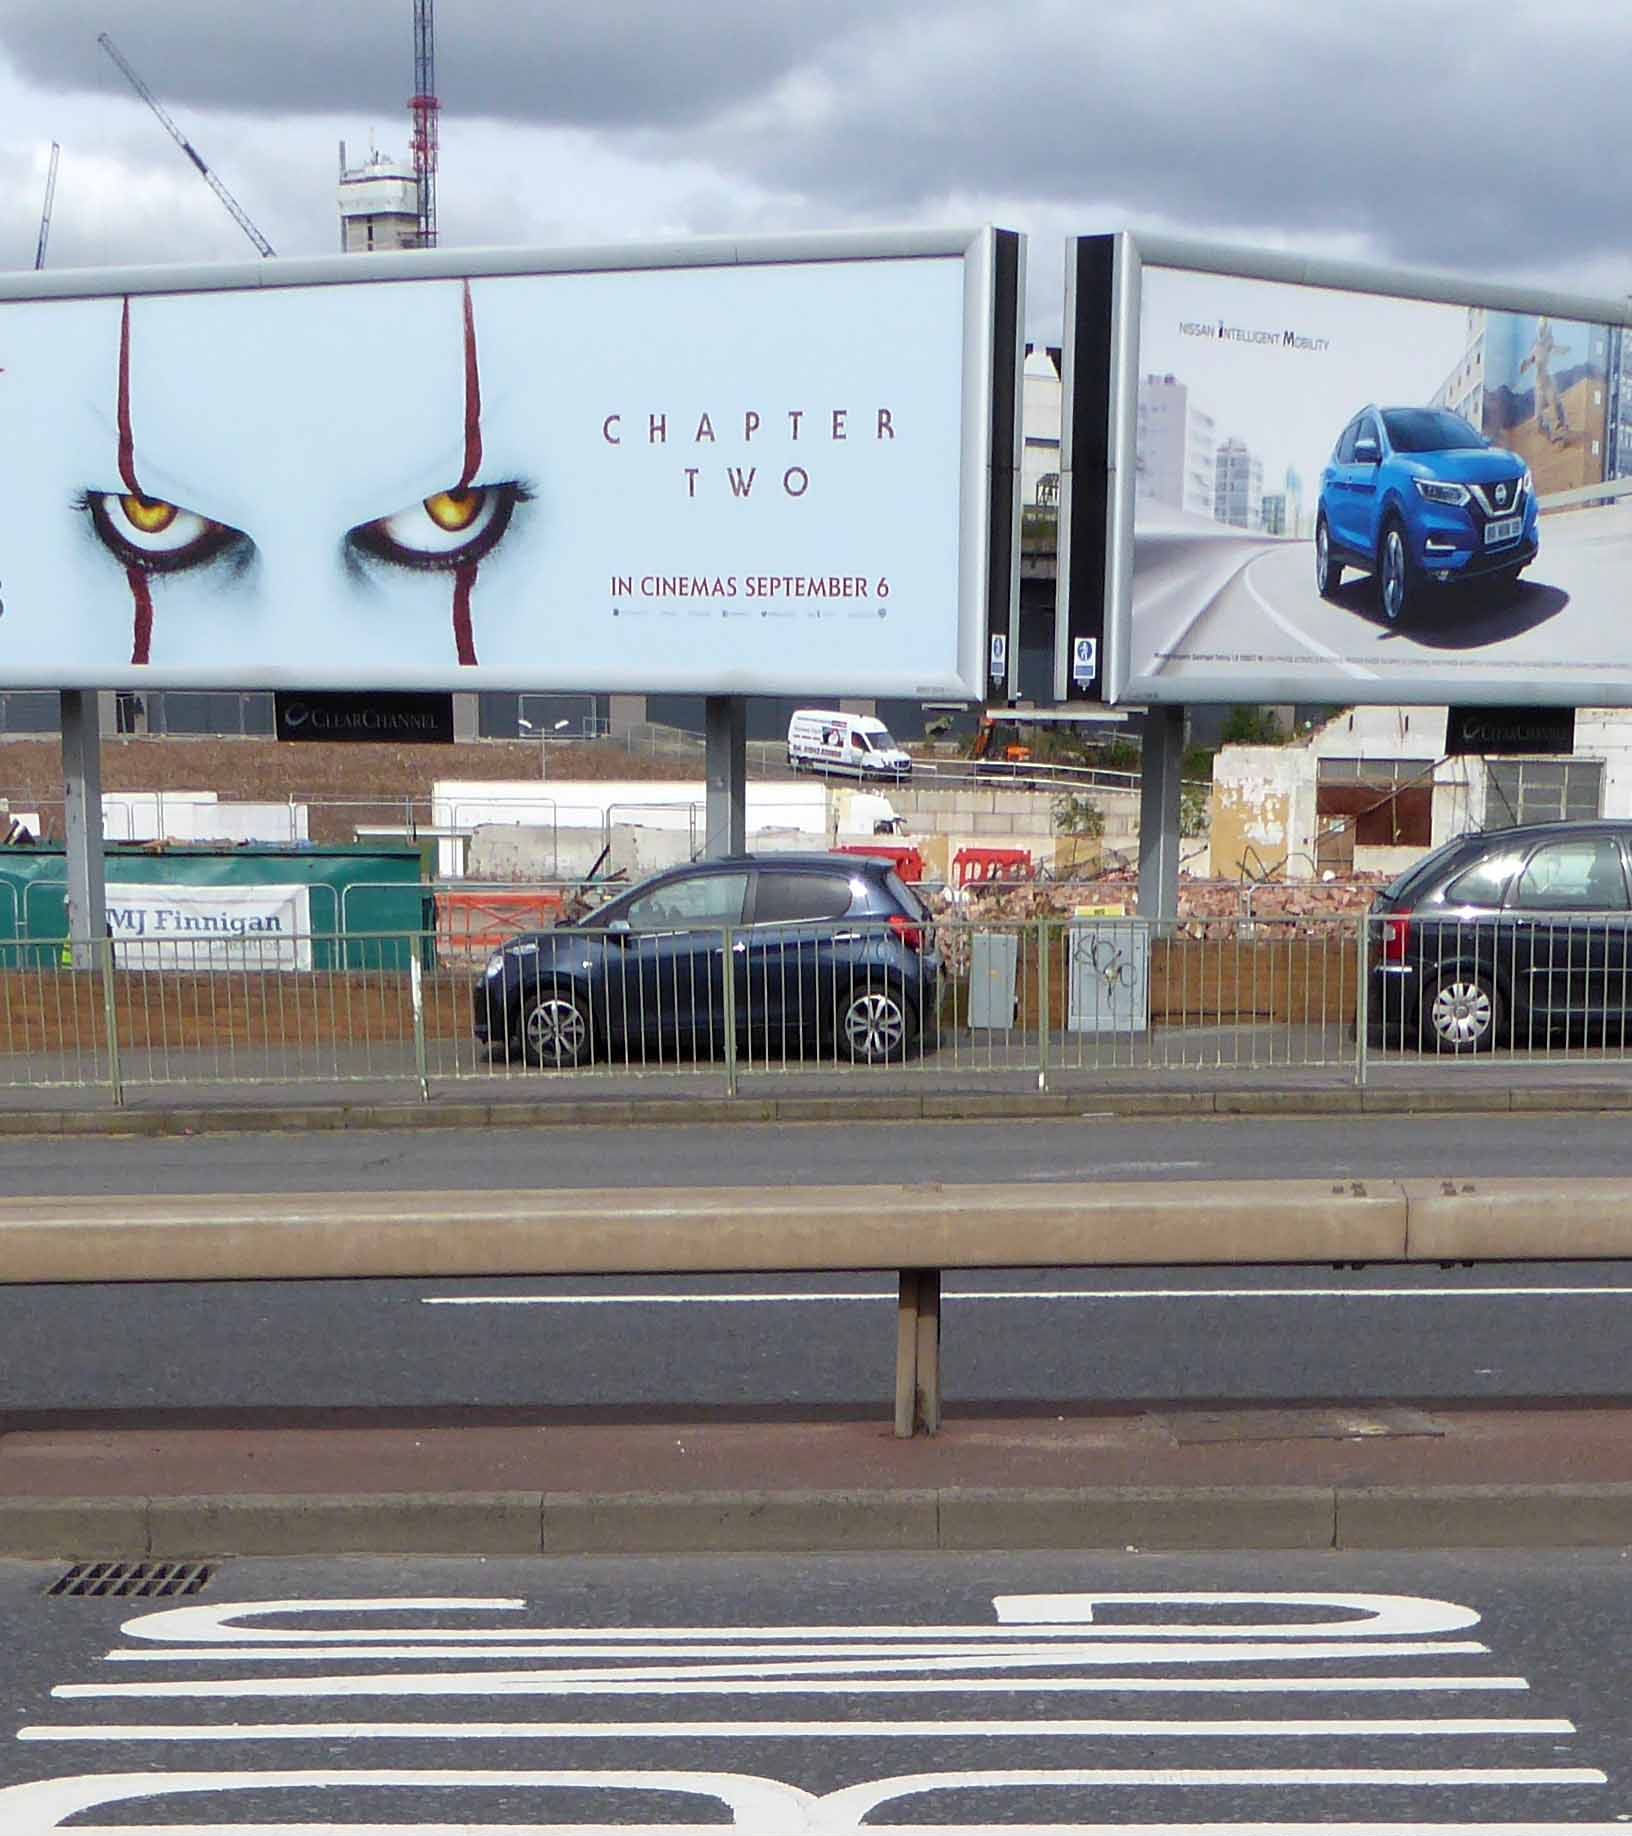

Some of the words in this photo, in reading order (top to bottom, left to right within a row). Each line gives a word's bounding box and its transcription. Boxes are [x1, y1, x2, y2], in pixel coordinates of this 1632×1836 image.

[1179, 321, 1215, 337] NISSAN
[1283, 330, 1330, 351] MOBILITY
[602, 408, 896, 445] CHAPTER
[683, 466, 810, 498] TWO
[610, 576, 633, 597] IN
[640, 576, 738, 597] CINEMAS
[744, 576, 869, 598] SEPTEMBER
[876, 577, 890, 598] 6
[104, 908, 147, 936] MJ
[153, 909, 283, 937] Finnigan
